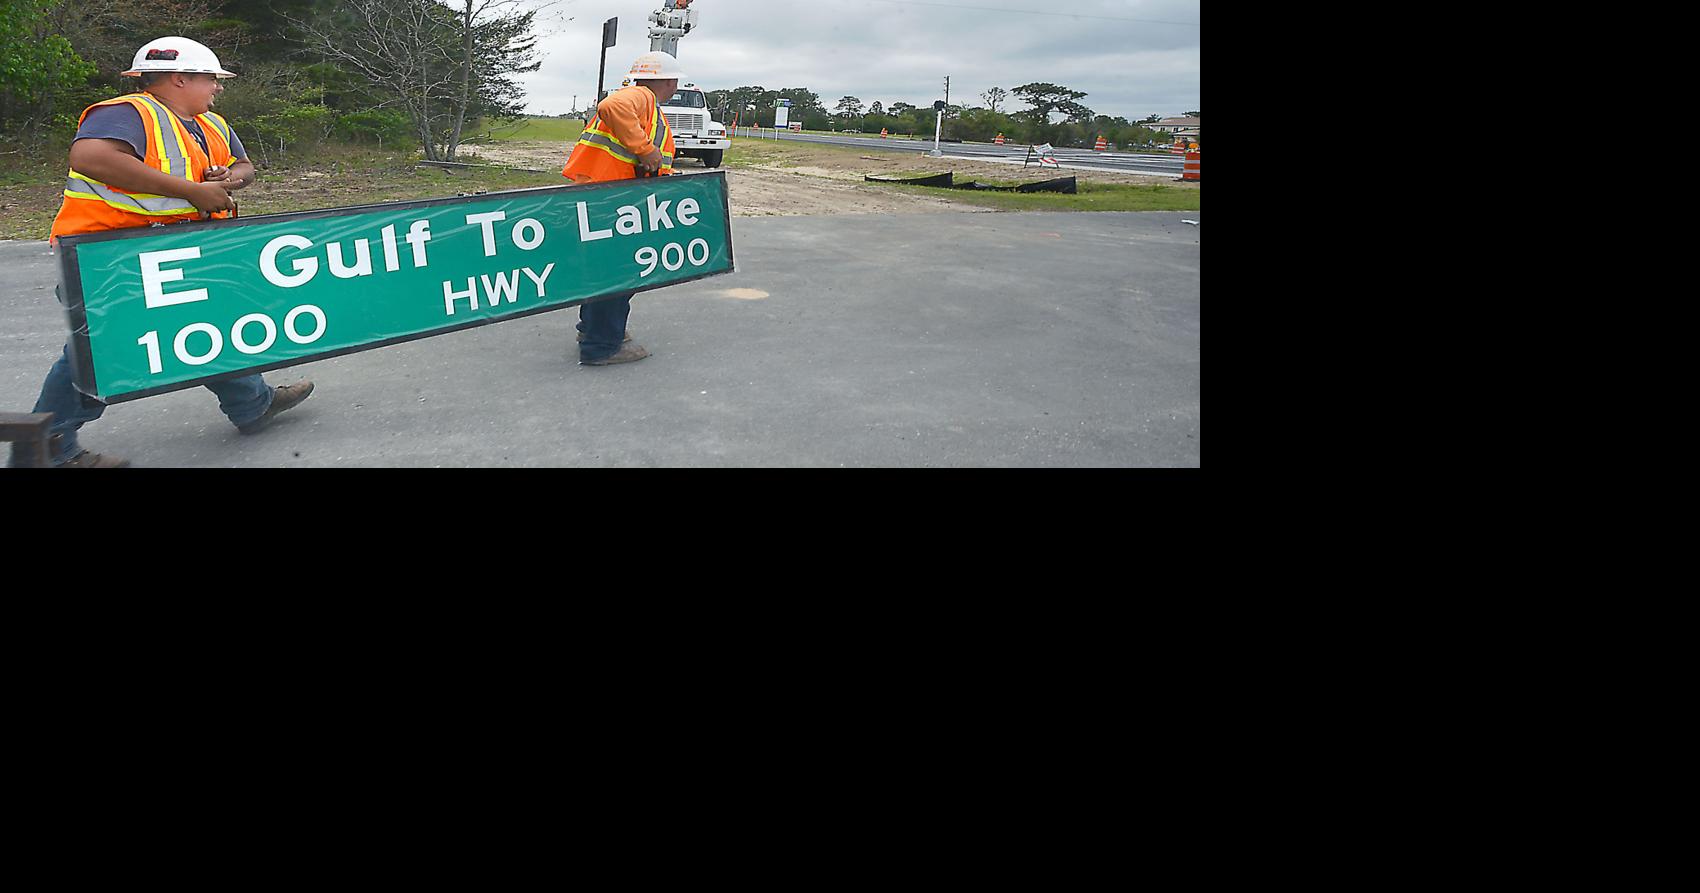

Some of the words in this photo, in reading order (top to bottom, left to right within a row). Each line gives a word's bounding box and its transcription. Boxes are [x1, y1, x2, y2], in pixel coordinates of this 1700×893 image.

[137, 304, 327, 374] 1000
[443, 263, 555, 316] HWY
[634, 237, 710, 278] 900
[138, 246, 209, 309] E
[259, 219, 432, 288] Gulf
[465, 210, 545, 257] To
[576, 193, 700, 242] Lake
